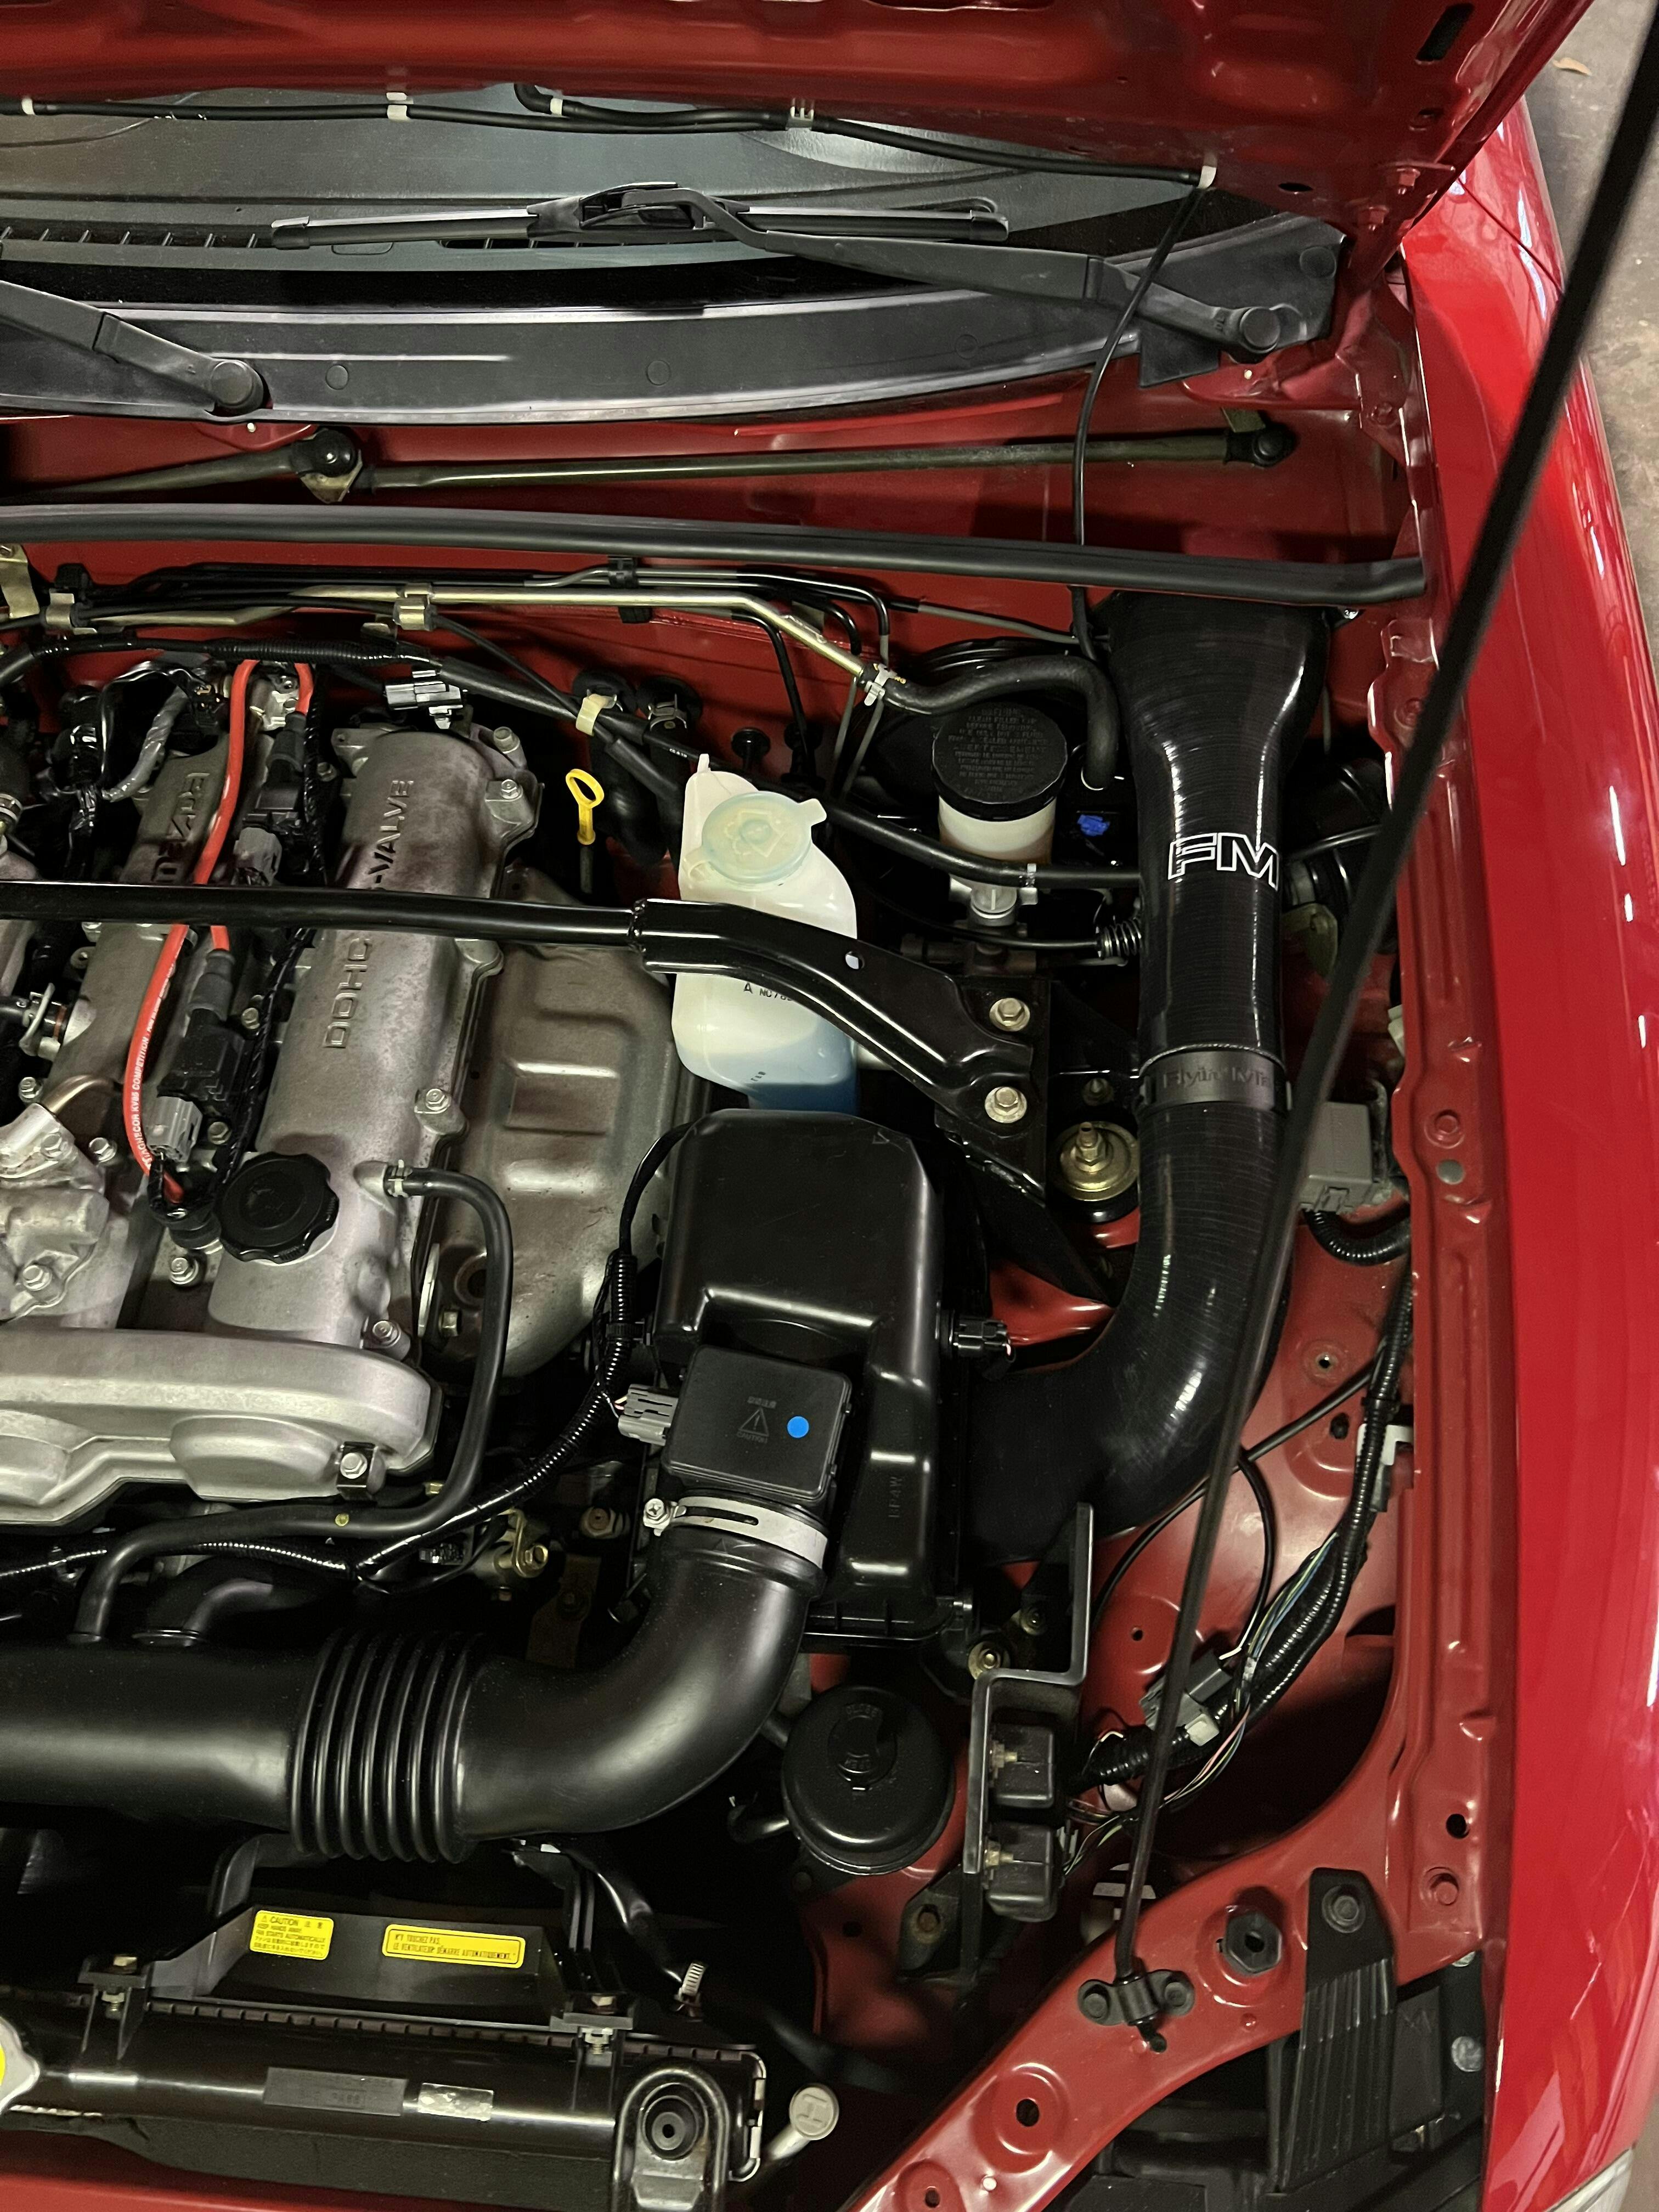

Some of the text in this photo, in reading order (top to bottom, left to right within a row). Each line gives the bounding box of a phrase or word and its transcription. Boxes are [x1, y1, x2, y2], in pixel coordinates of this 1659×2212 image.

[368, 780, 415, 889] -VALVE
[1167, 832, 1279, 891] FM
[323, 936, 373, 1049] DOHC
[132, 1036, 149, 1090] COMPETITION
[736, 1431, 768, 1444] CAUTION
[269, 1916, 298, 1927] CAUTION
[406, 1934, 428, 1944] TOUCHEZ
